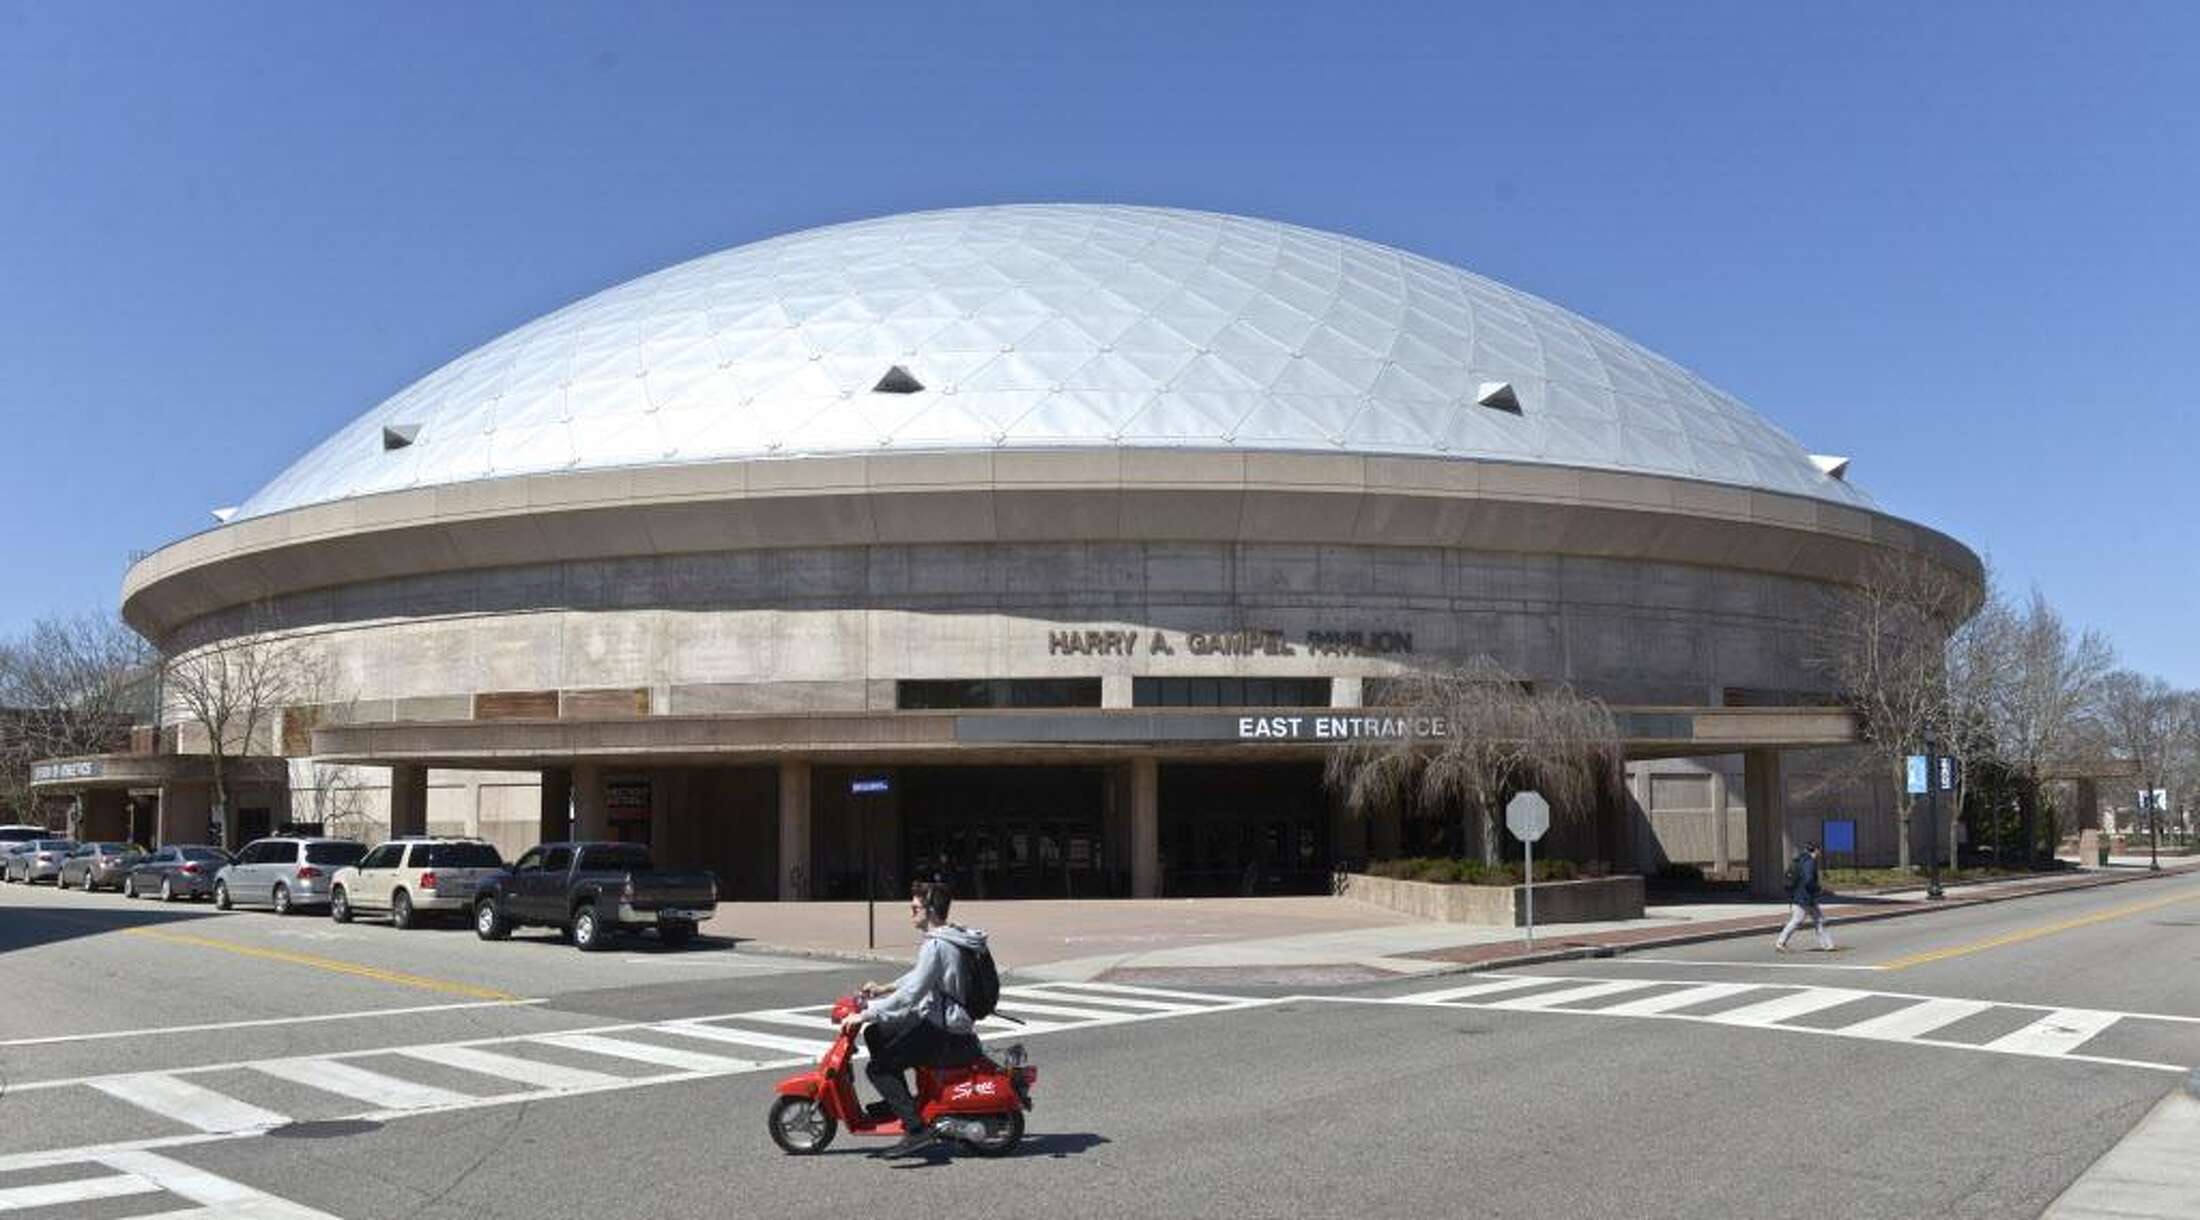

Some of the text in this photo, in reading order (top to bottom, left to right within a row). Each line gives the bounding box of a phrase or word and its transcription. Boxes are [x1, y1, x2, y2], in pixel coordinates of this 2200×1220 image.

[1048, 630, 1137, 656] HARRY
[1150, 631, 1174, 656] A.
[1187, 630, 1295, 656] GAMPEL
[1239, 717, 1446, 737] EAST ENTRANCE
